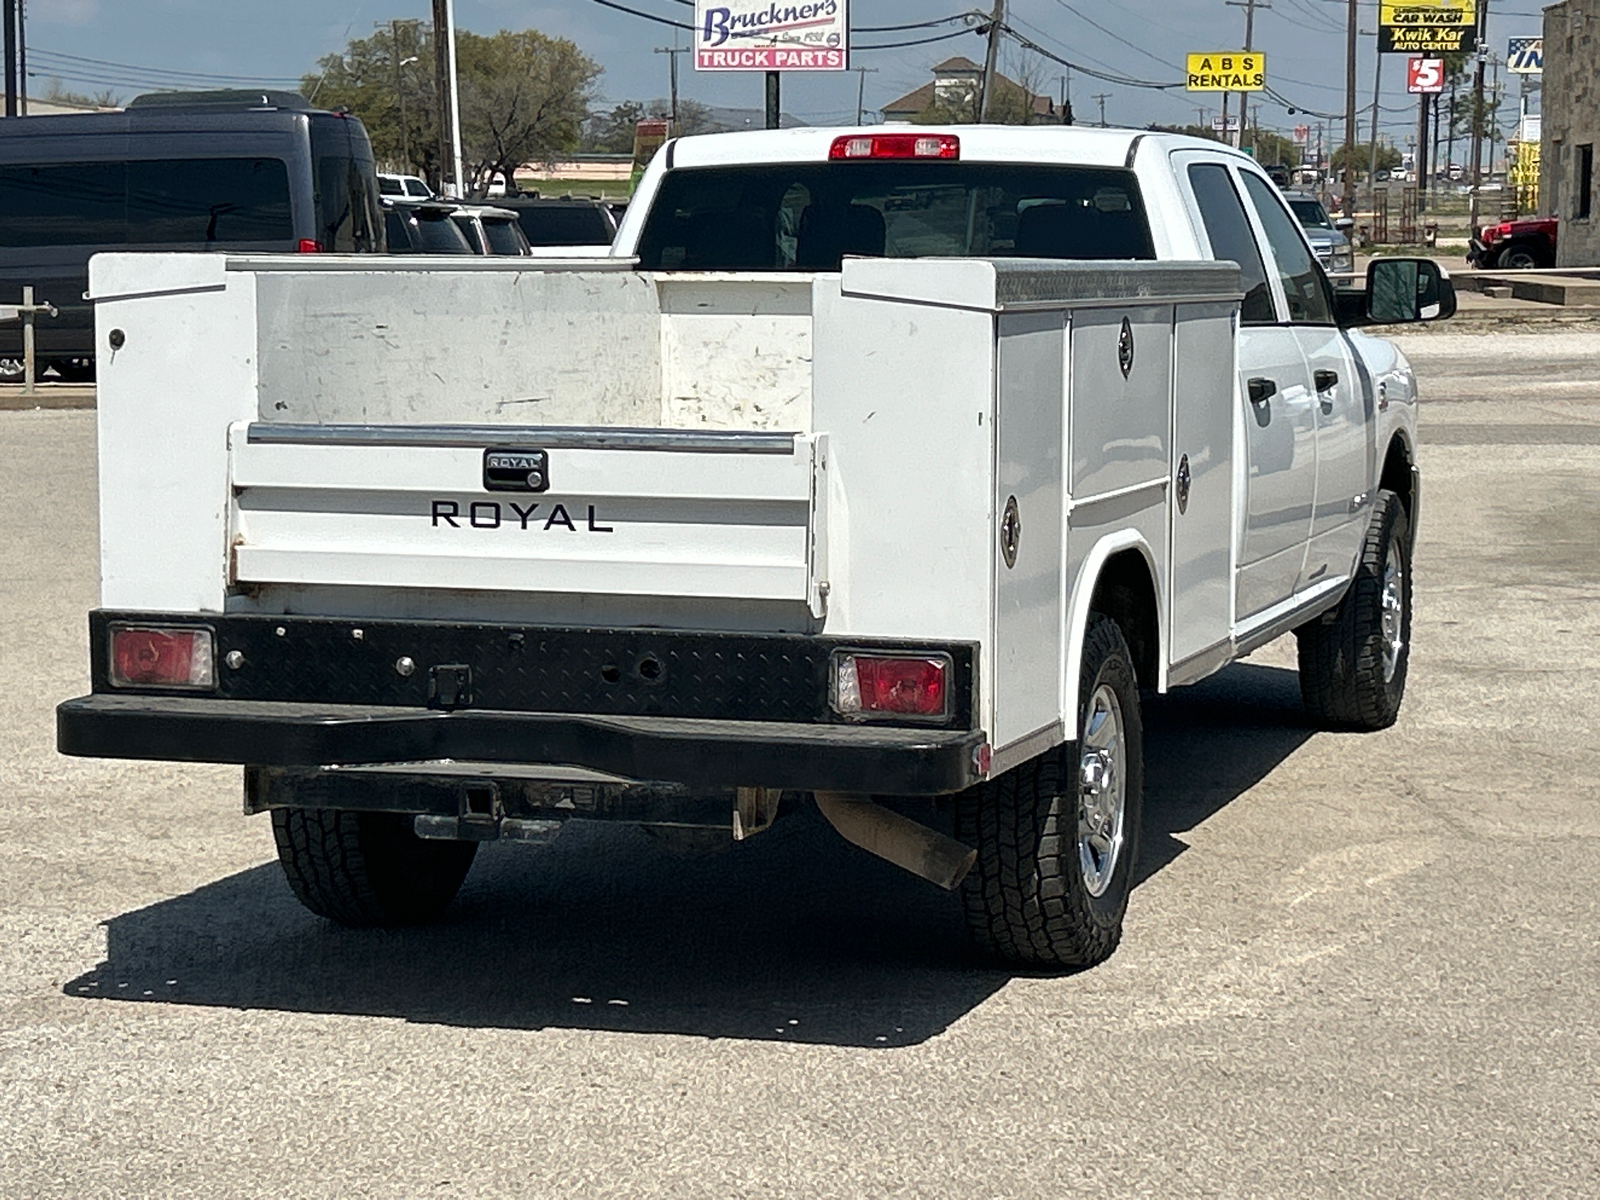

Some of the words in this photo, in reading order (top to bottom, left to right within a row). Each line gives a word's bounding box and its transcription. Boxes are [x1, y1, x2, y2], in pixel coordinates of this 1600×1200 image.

[703, 0, 837, 47] Bruckner's
[1393, 14, 1420, 23] CAR
[1423, 14, 1463, 23] WASH
[1390, 27, 1432, 41] Kwik
[1435, 27, 1464, 41] Kar
[1393, 42, 1420, 50] AUTO
[1421, 42, 1460, 50] CENTER
[700, 51, 769, 66] TRUCK
[775, 51, 840, 66] PARTS
[1188, 74, 1264, 87] RENTALS
[489, 457, 541, 468] ROYAL
[431, 500, 614, 533] ROYAL
